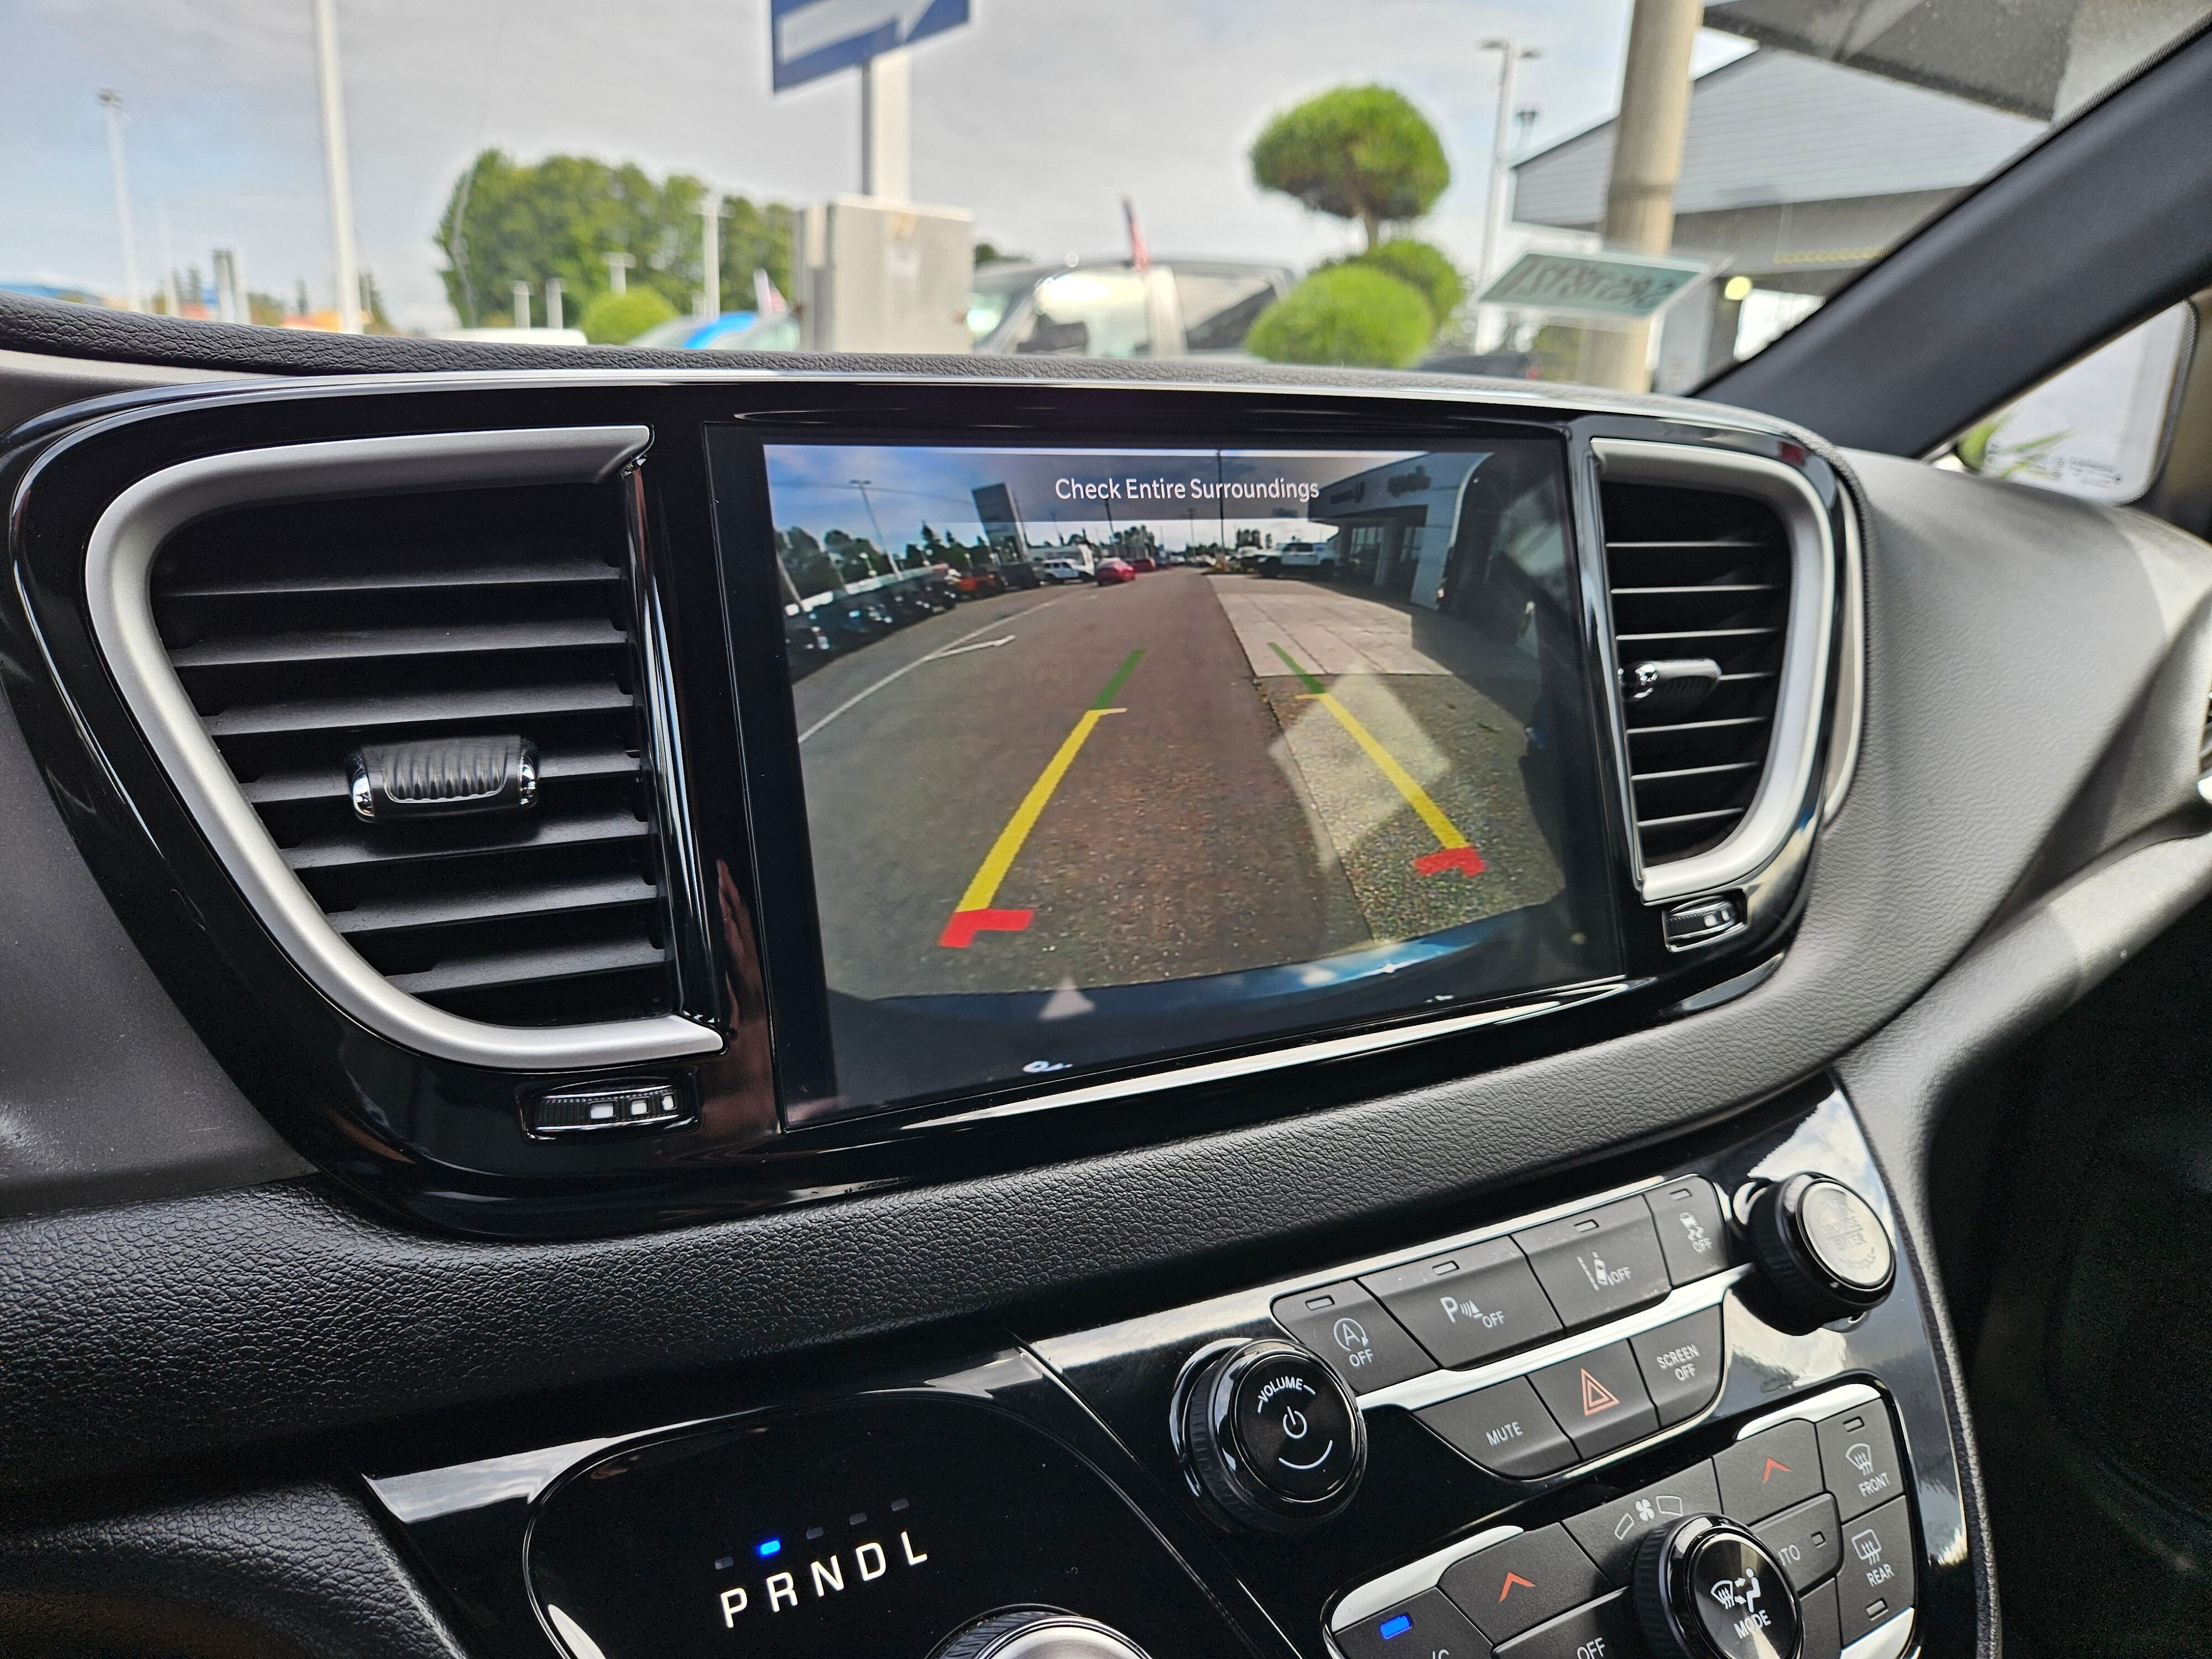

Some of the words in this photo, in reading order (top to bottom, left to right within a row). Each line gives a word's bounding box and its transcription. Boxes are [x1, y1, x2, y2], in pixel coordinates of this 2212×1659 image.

[1055, 478, 1121, 499] Check
[1126, 478, 1186, 499] Entire
[1190, 477, 1319, 503] Surroundings
[1692, 1238, 1712, 1253] OFF
[1610, 1266, 1631, 1283] OFF
[1439, 1296, 1459, 1323] P
[1482, 1311, 1505, 1328] OFF
[1349, 1348, 1374, 1368] OFF
[1656, 1344, 1700, 1370] SCREEN
[1674, 1363, 1696, 1381] OFF
[1258, 1375, 1303, 1403] VOLUME
[1485, 1421, 1523, 1446] MUTE
[1858, 1472, 1891, 1497] FRONT
[1777, 1544, 1801, 1567] TO
[721, 1587, 748, 1628] P
[766, 1572, 798, 1612] R
[811, 1555, 844, 1597] N
[855, 1542, 886, 1582] D
[901, 1531, 928, 1566] L
[1865, 1564, 1895, 1587] REAR
[1734, 1610, 1772, 1639] MODE
[1577, 1637, 1605, 1659] OFF
